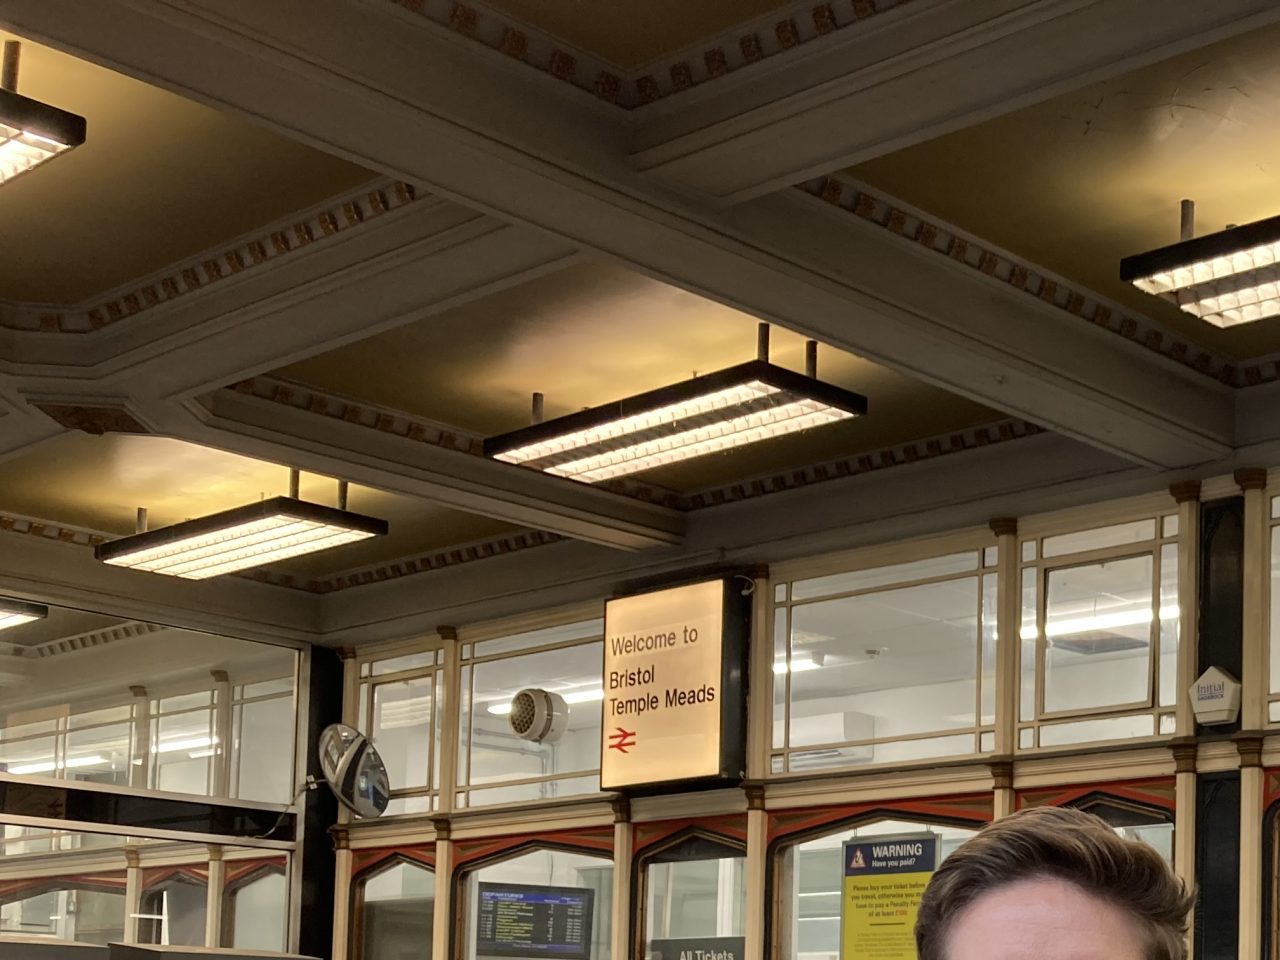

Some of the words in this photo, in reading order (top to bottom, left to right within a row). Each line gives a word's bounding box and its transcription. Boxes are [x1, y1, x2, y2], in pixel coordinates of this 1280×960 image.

[611, 631, 676, 656] Welcome
[683, 625, 698, 644] to
[610, 664, 655, 689] Bristol
[610, 692, 659, 716] Temple
[665, 684, 715, 708] Meads
[872, 843, 923, 858] WARNING
[888, 860, 899, 868] you
[899, 858, 916, 868] paid?
